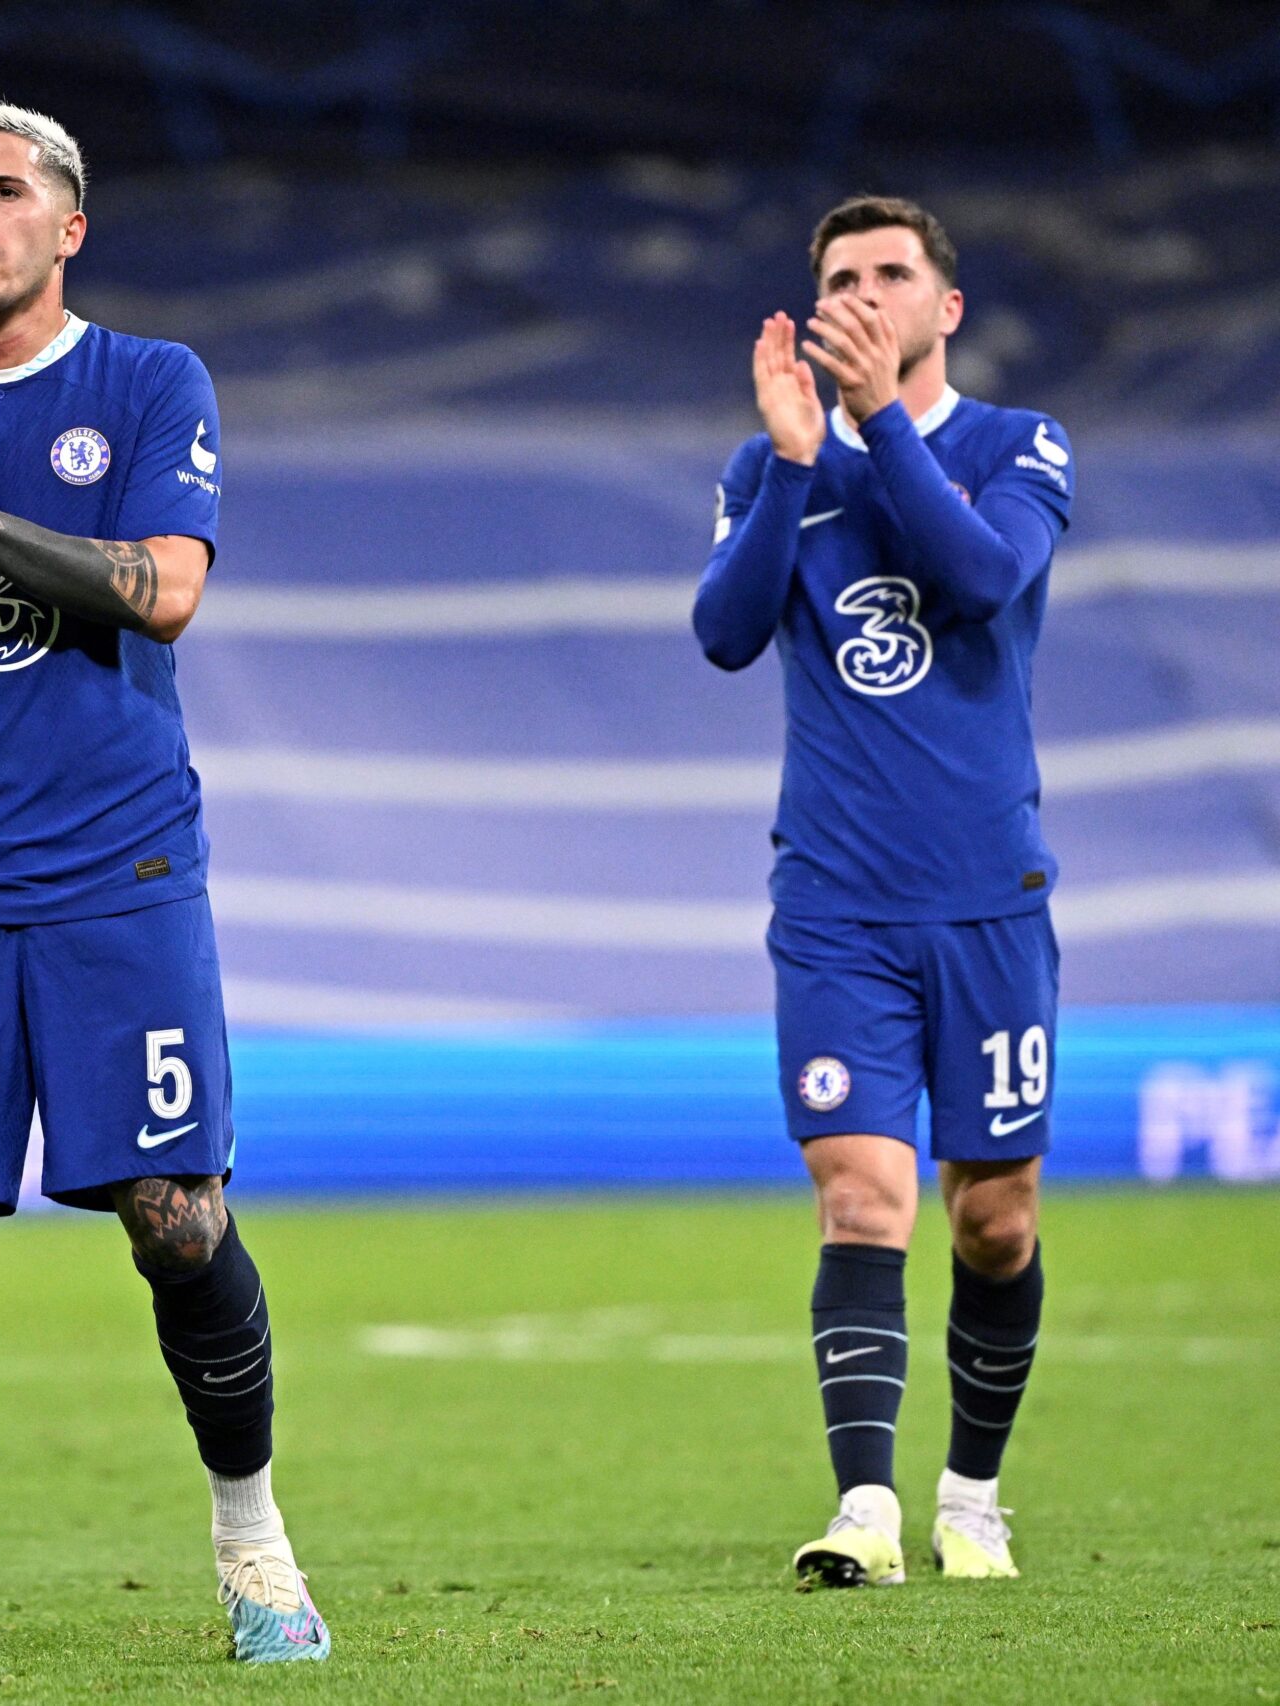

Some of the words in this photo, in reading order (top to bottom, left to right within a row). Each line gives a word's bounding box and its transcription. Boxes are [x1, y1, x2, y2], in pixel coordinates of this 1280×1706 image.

[60, 429, 98, 443] CHELSEA
[145, 1027, 193, 1120] 5
[981, 1024, 1048, 1109] 19
